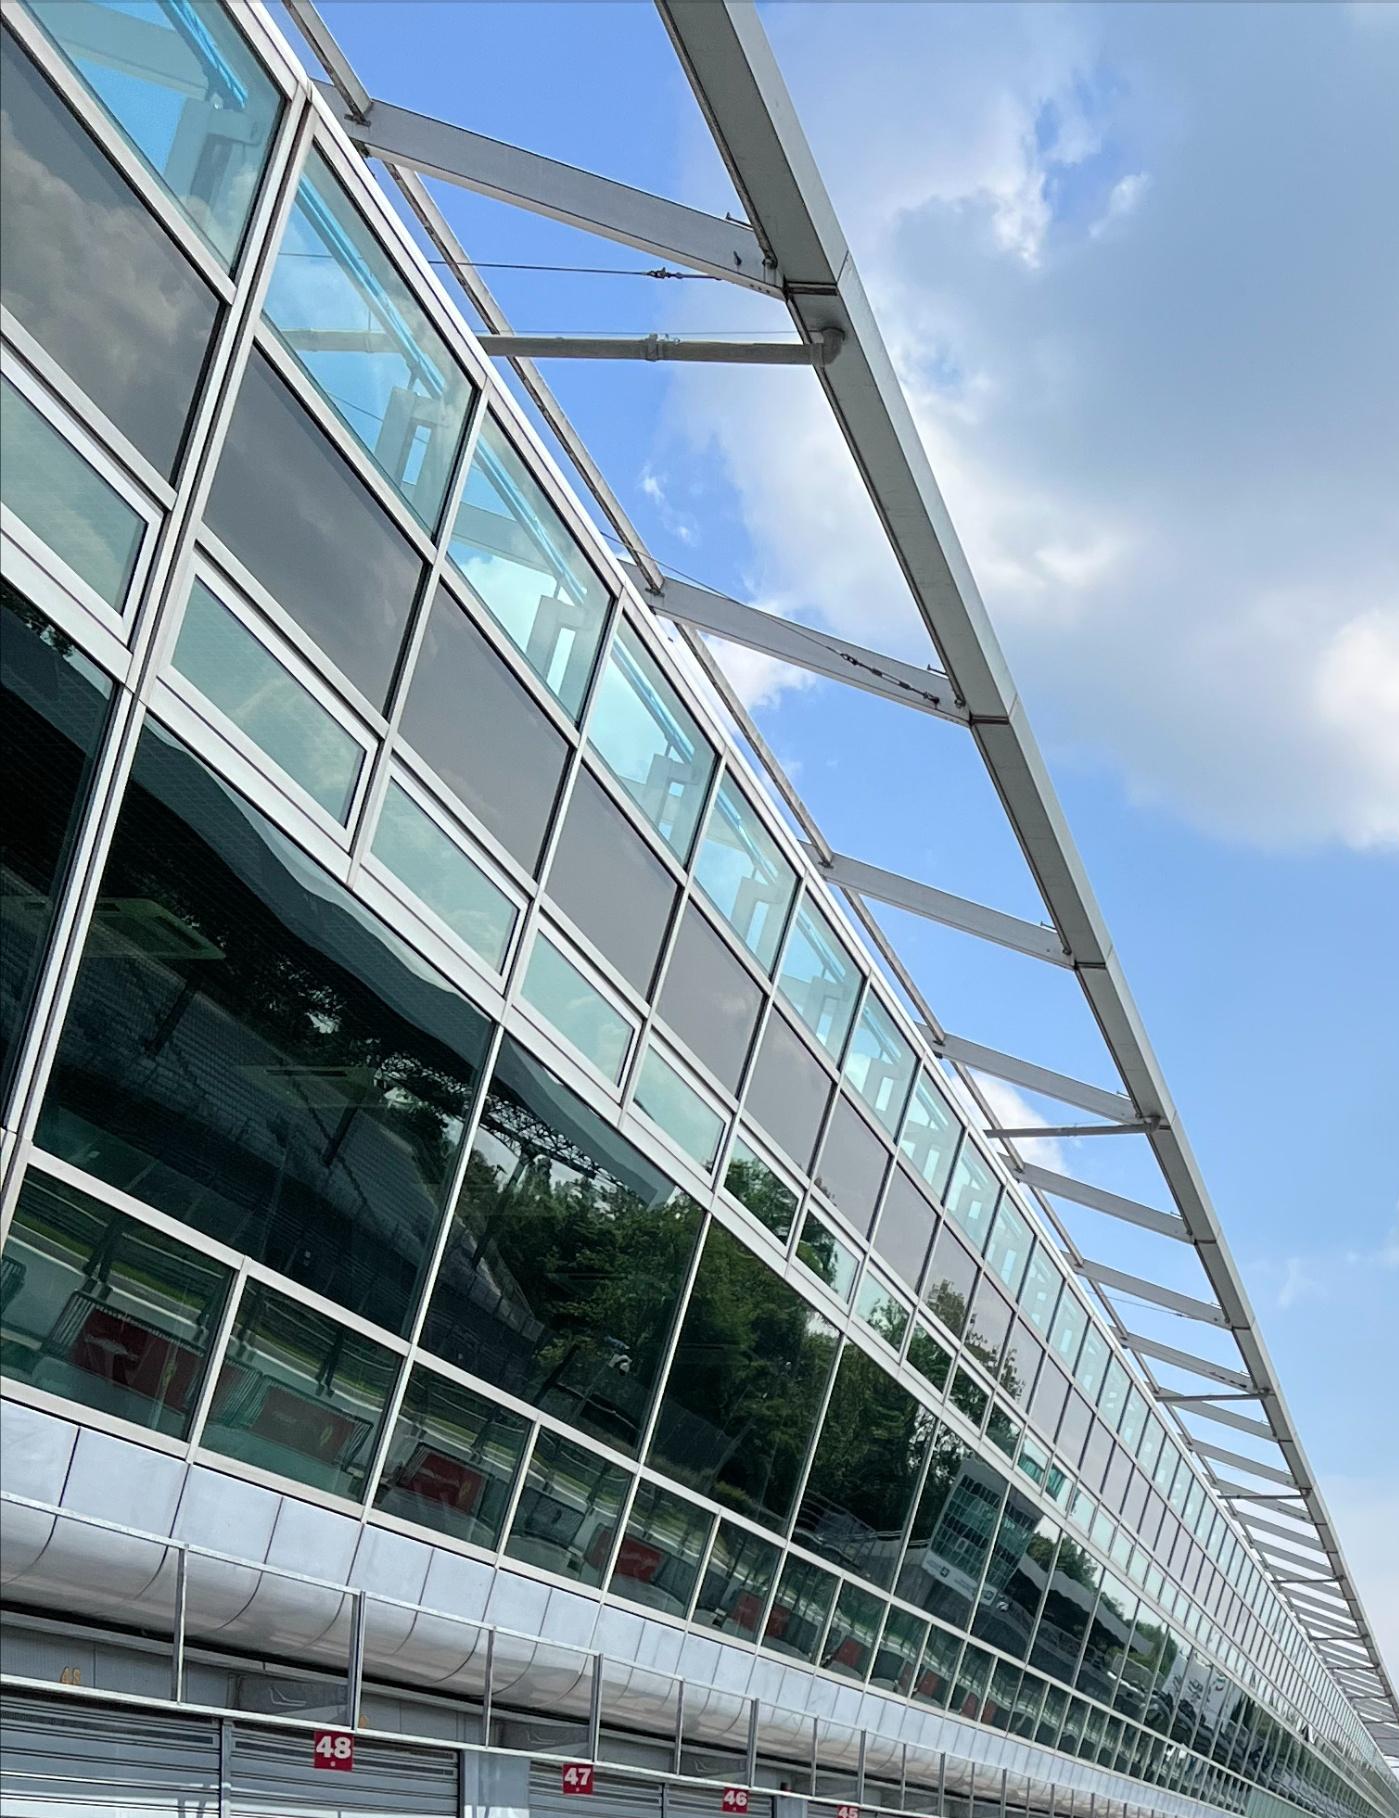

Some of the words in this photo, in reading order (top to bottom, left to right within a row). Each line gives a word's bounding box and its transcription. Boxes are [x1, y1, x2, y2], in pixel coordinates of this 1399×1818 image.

[315, 1735, 351, 1760] 48
[564, 1767, 591, 1786] 47
[723, 1791, 748, 1807] 46
